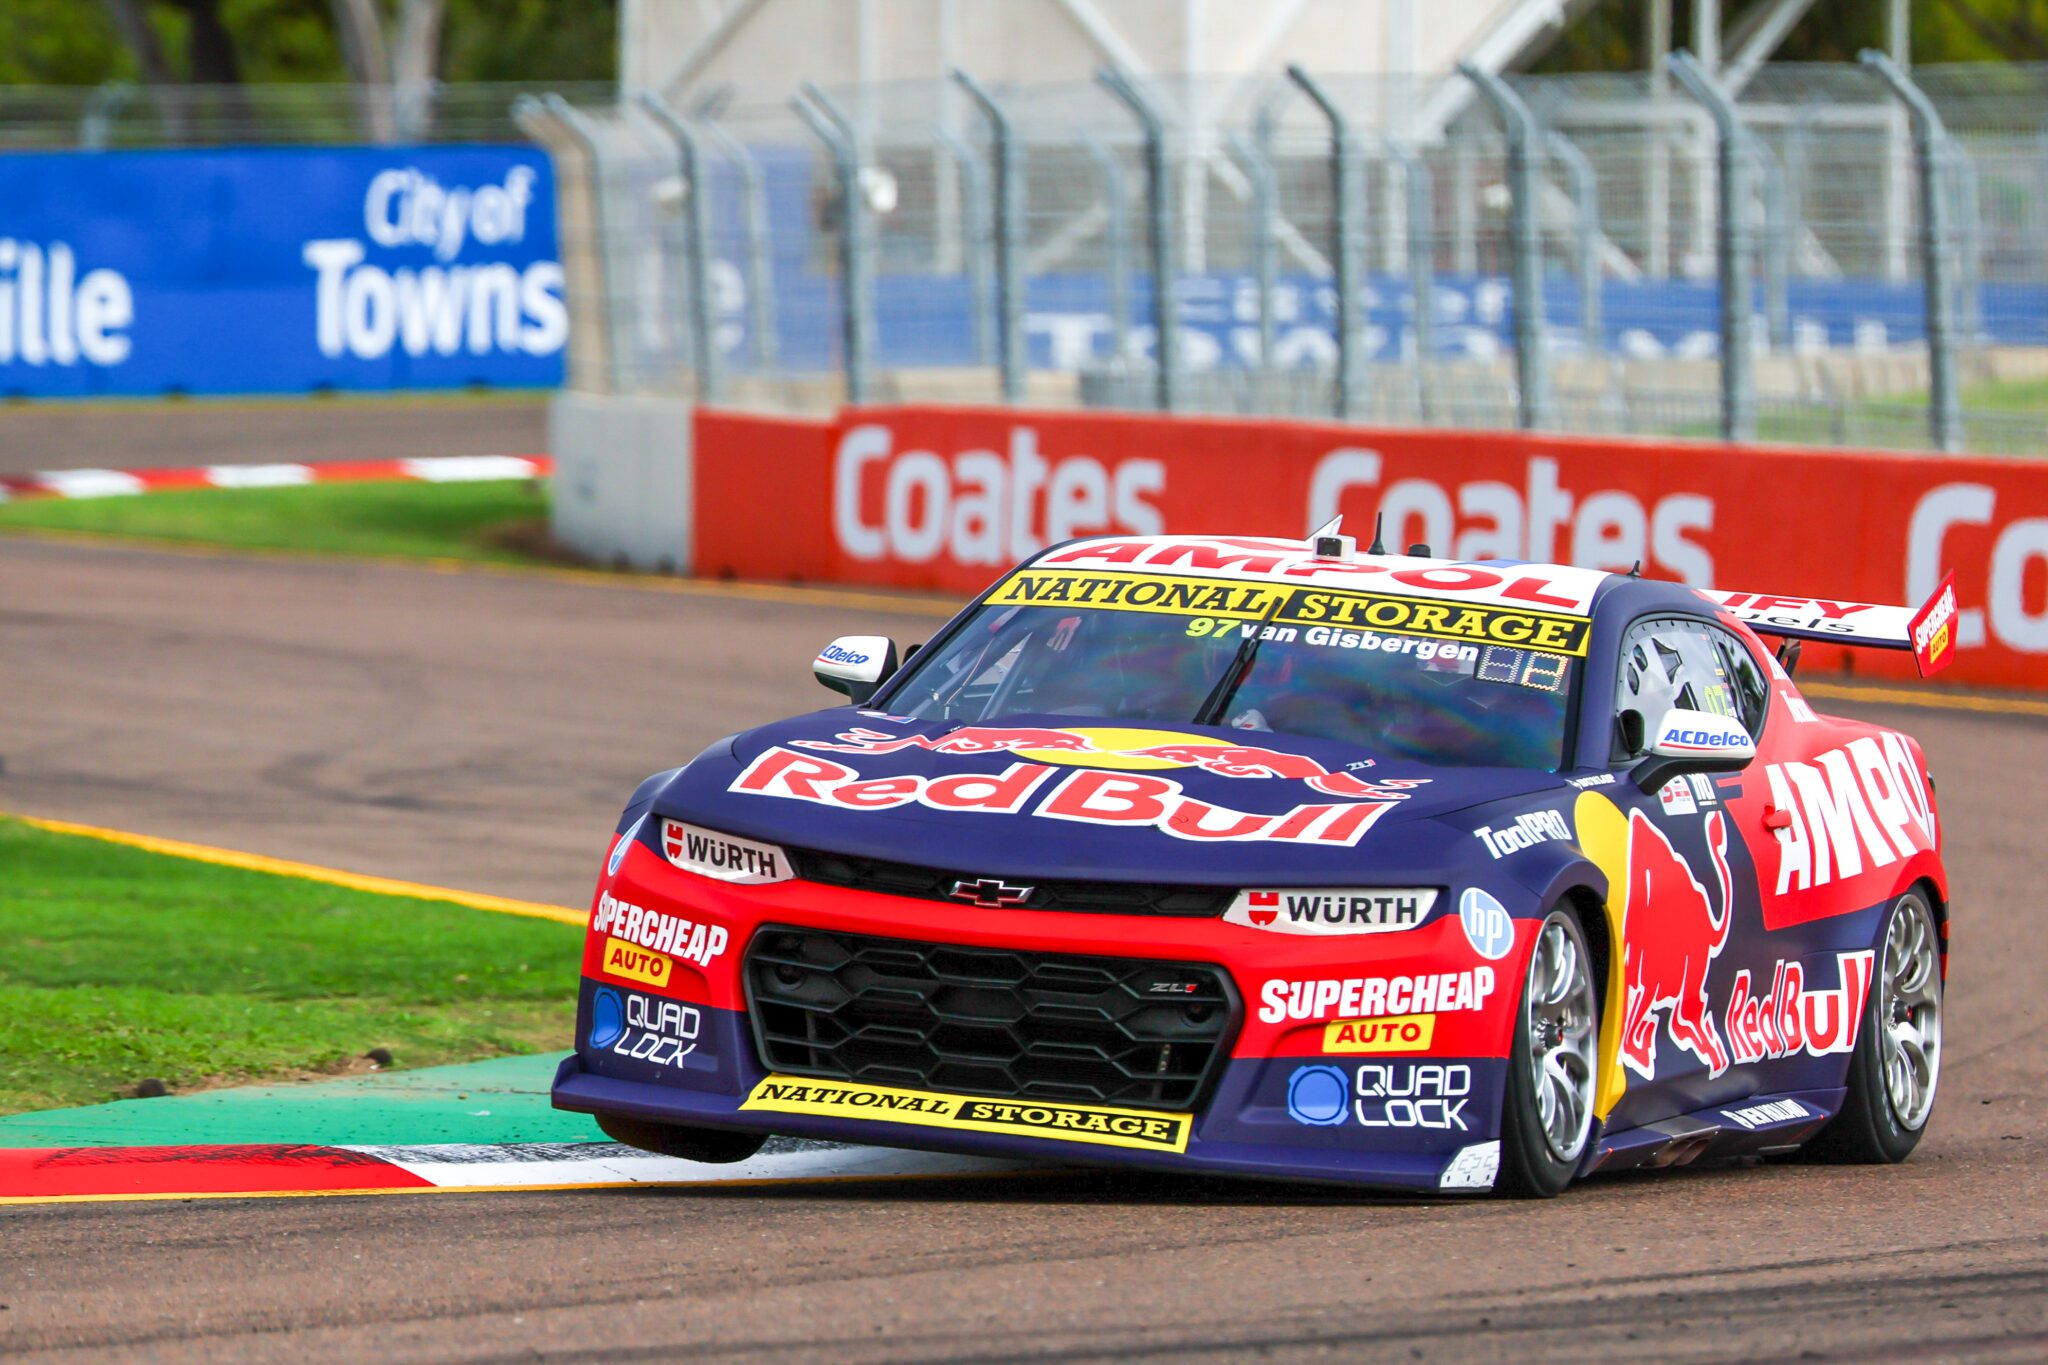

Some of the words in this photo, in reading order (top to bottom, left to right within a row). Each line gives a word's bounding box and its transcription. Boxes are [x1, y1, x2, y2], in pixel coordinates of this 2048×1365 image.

[364, 167, 471, 262] City
[471, 164, 538, 246] of
[302, 238, 571, 358] Towns
[835, 424, 1167, 566] Coates
[1309, 446, 1716, 588] Coates
[1044, 542, 1583, 609] AMPOL
[1003, 577, 1270, 614] NATIONAL
[1298, 593, 1575, 648] STORAGE
[1185, 618, 1243, 638] 97
[1241, 623, 1298, 645] van
[1305, 627, 1480, 662] Gisbergen
[1663, 729, 1749, 747] ACDelco
[727, 746, 1061, 813] Red
[1032, 769, 1402, 847] Bull
[686, 833, 777, 879] WÜRTH
[593, 890, 729, 967] SUPERCHEAP
[1287, 896, 1418, 924] WÜRTH
[1469, 900, 1505, 956] hp
[610, 948, 664, 977] AUTO
[627, 994, 701, 1040] QUAD
[1258, 966, 1495, 1024] SUPERCHEAP
[1725, 958, 1785, 1064] Red
[1778, 949, 1876, 1058] Bull
[613, 1027, 697, 1069] LOCK
[1335, 1022, 1422, 1044] AUTO
[1356, 1065, 1471, 1098] QUAD
[756, 1083, 951, 1116] NATIONAL
[972, 1103, 1172, 1141] STORAGE
[1355, 1098, 1469, 1132] LOCK
